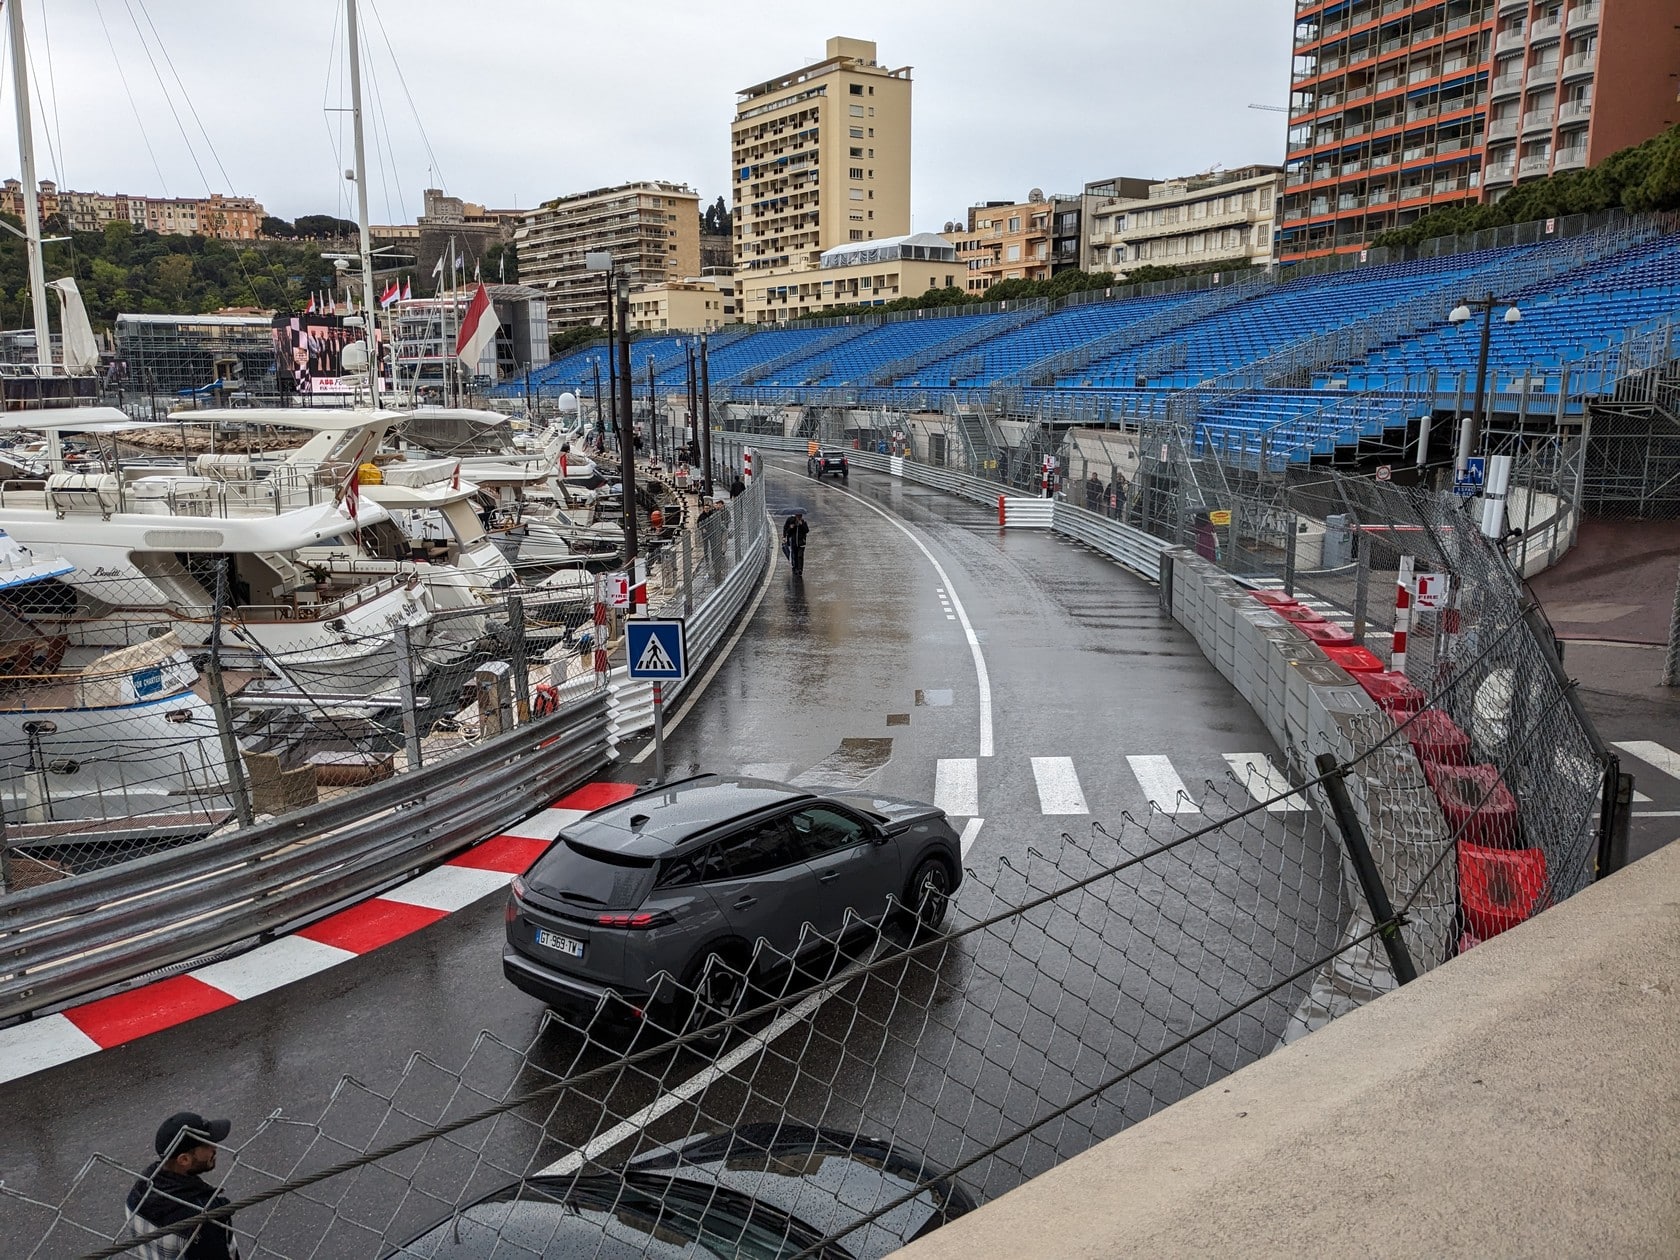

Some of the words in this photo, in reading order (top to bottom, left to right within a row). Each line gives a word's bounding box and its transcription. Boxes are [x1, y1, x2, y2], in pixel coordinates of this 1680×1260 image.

[385, 609, 405, 629] New
[402, 602, 418, 617] Star
[134, 680, 143, 688] FOR
[143, 675, 161, 686] CHARTER
